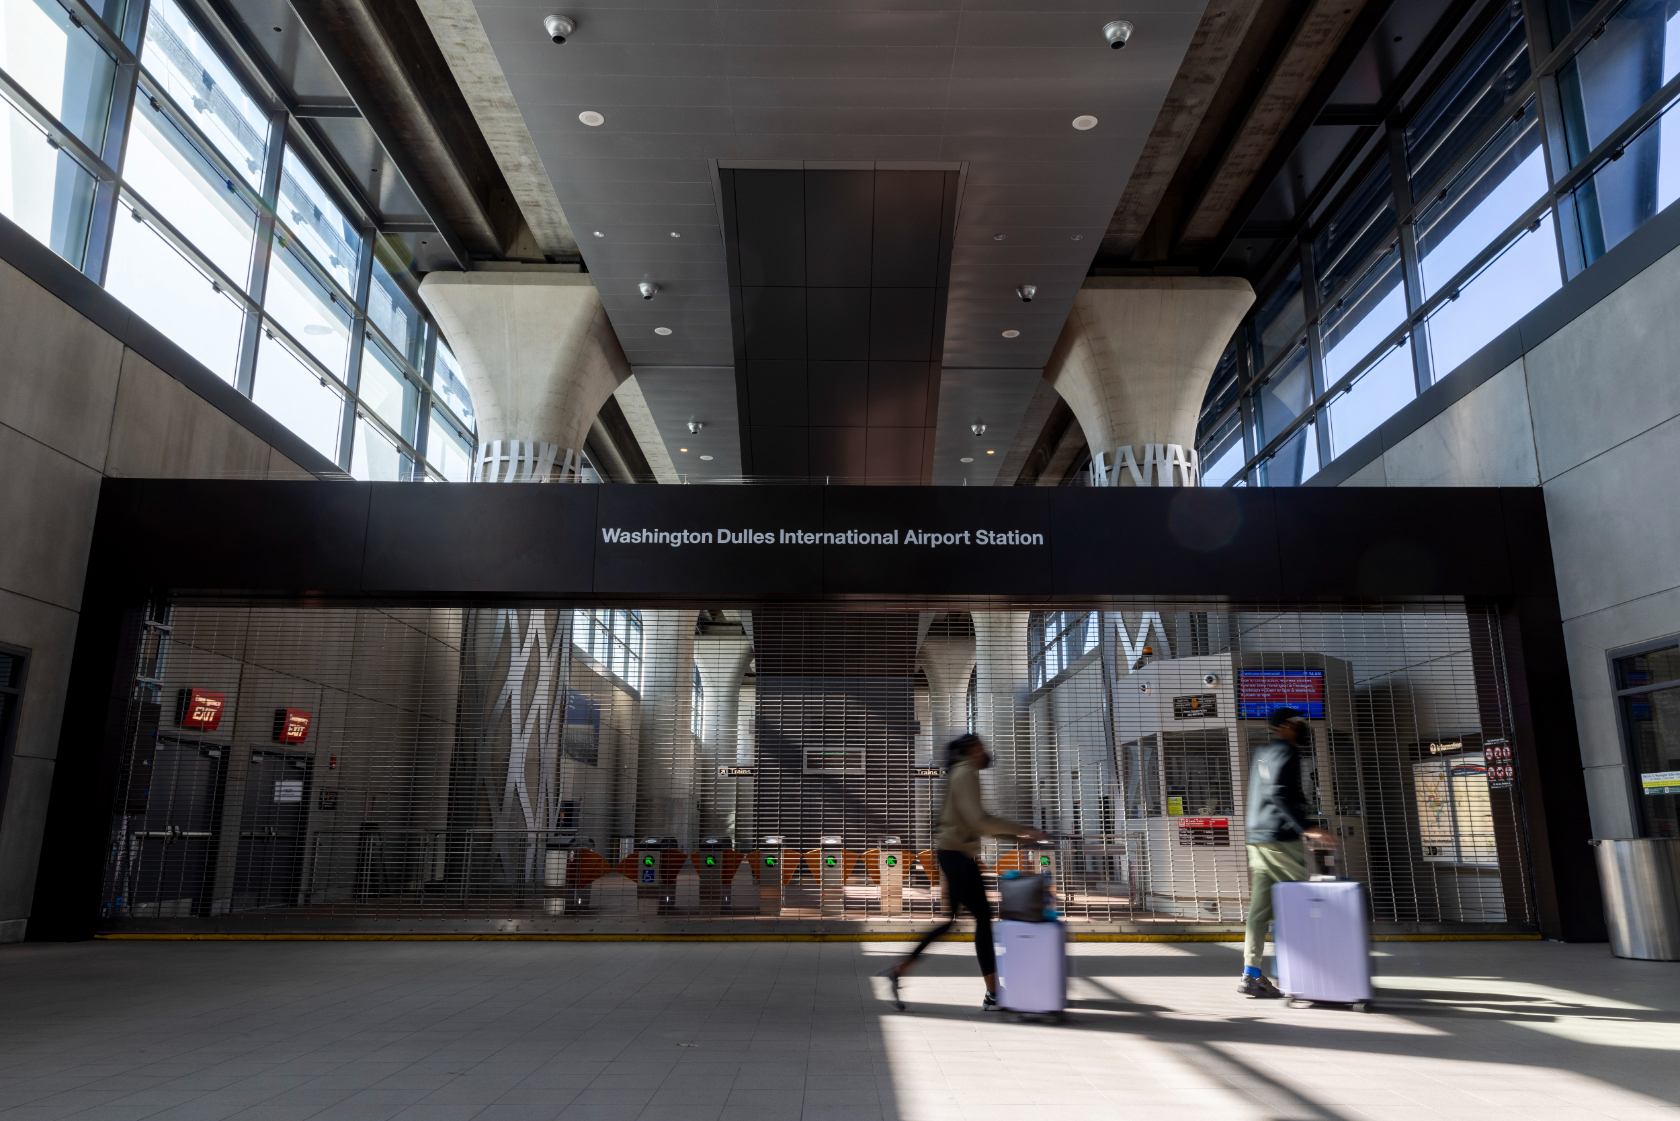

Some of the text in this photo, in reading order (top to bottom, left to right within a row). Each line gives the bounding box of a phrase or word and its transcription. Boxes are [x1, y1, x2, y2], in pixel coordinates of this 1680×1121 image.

[601, 527, 1044, 548] Washington Dulles International Airport Station
[192, 706, 218, 722] EXIT
[287, 723, 306, 737] EXIT
[1436, 742, 1462, 751] Information
